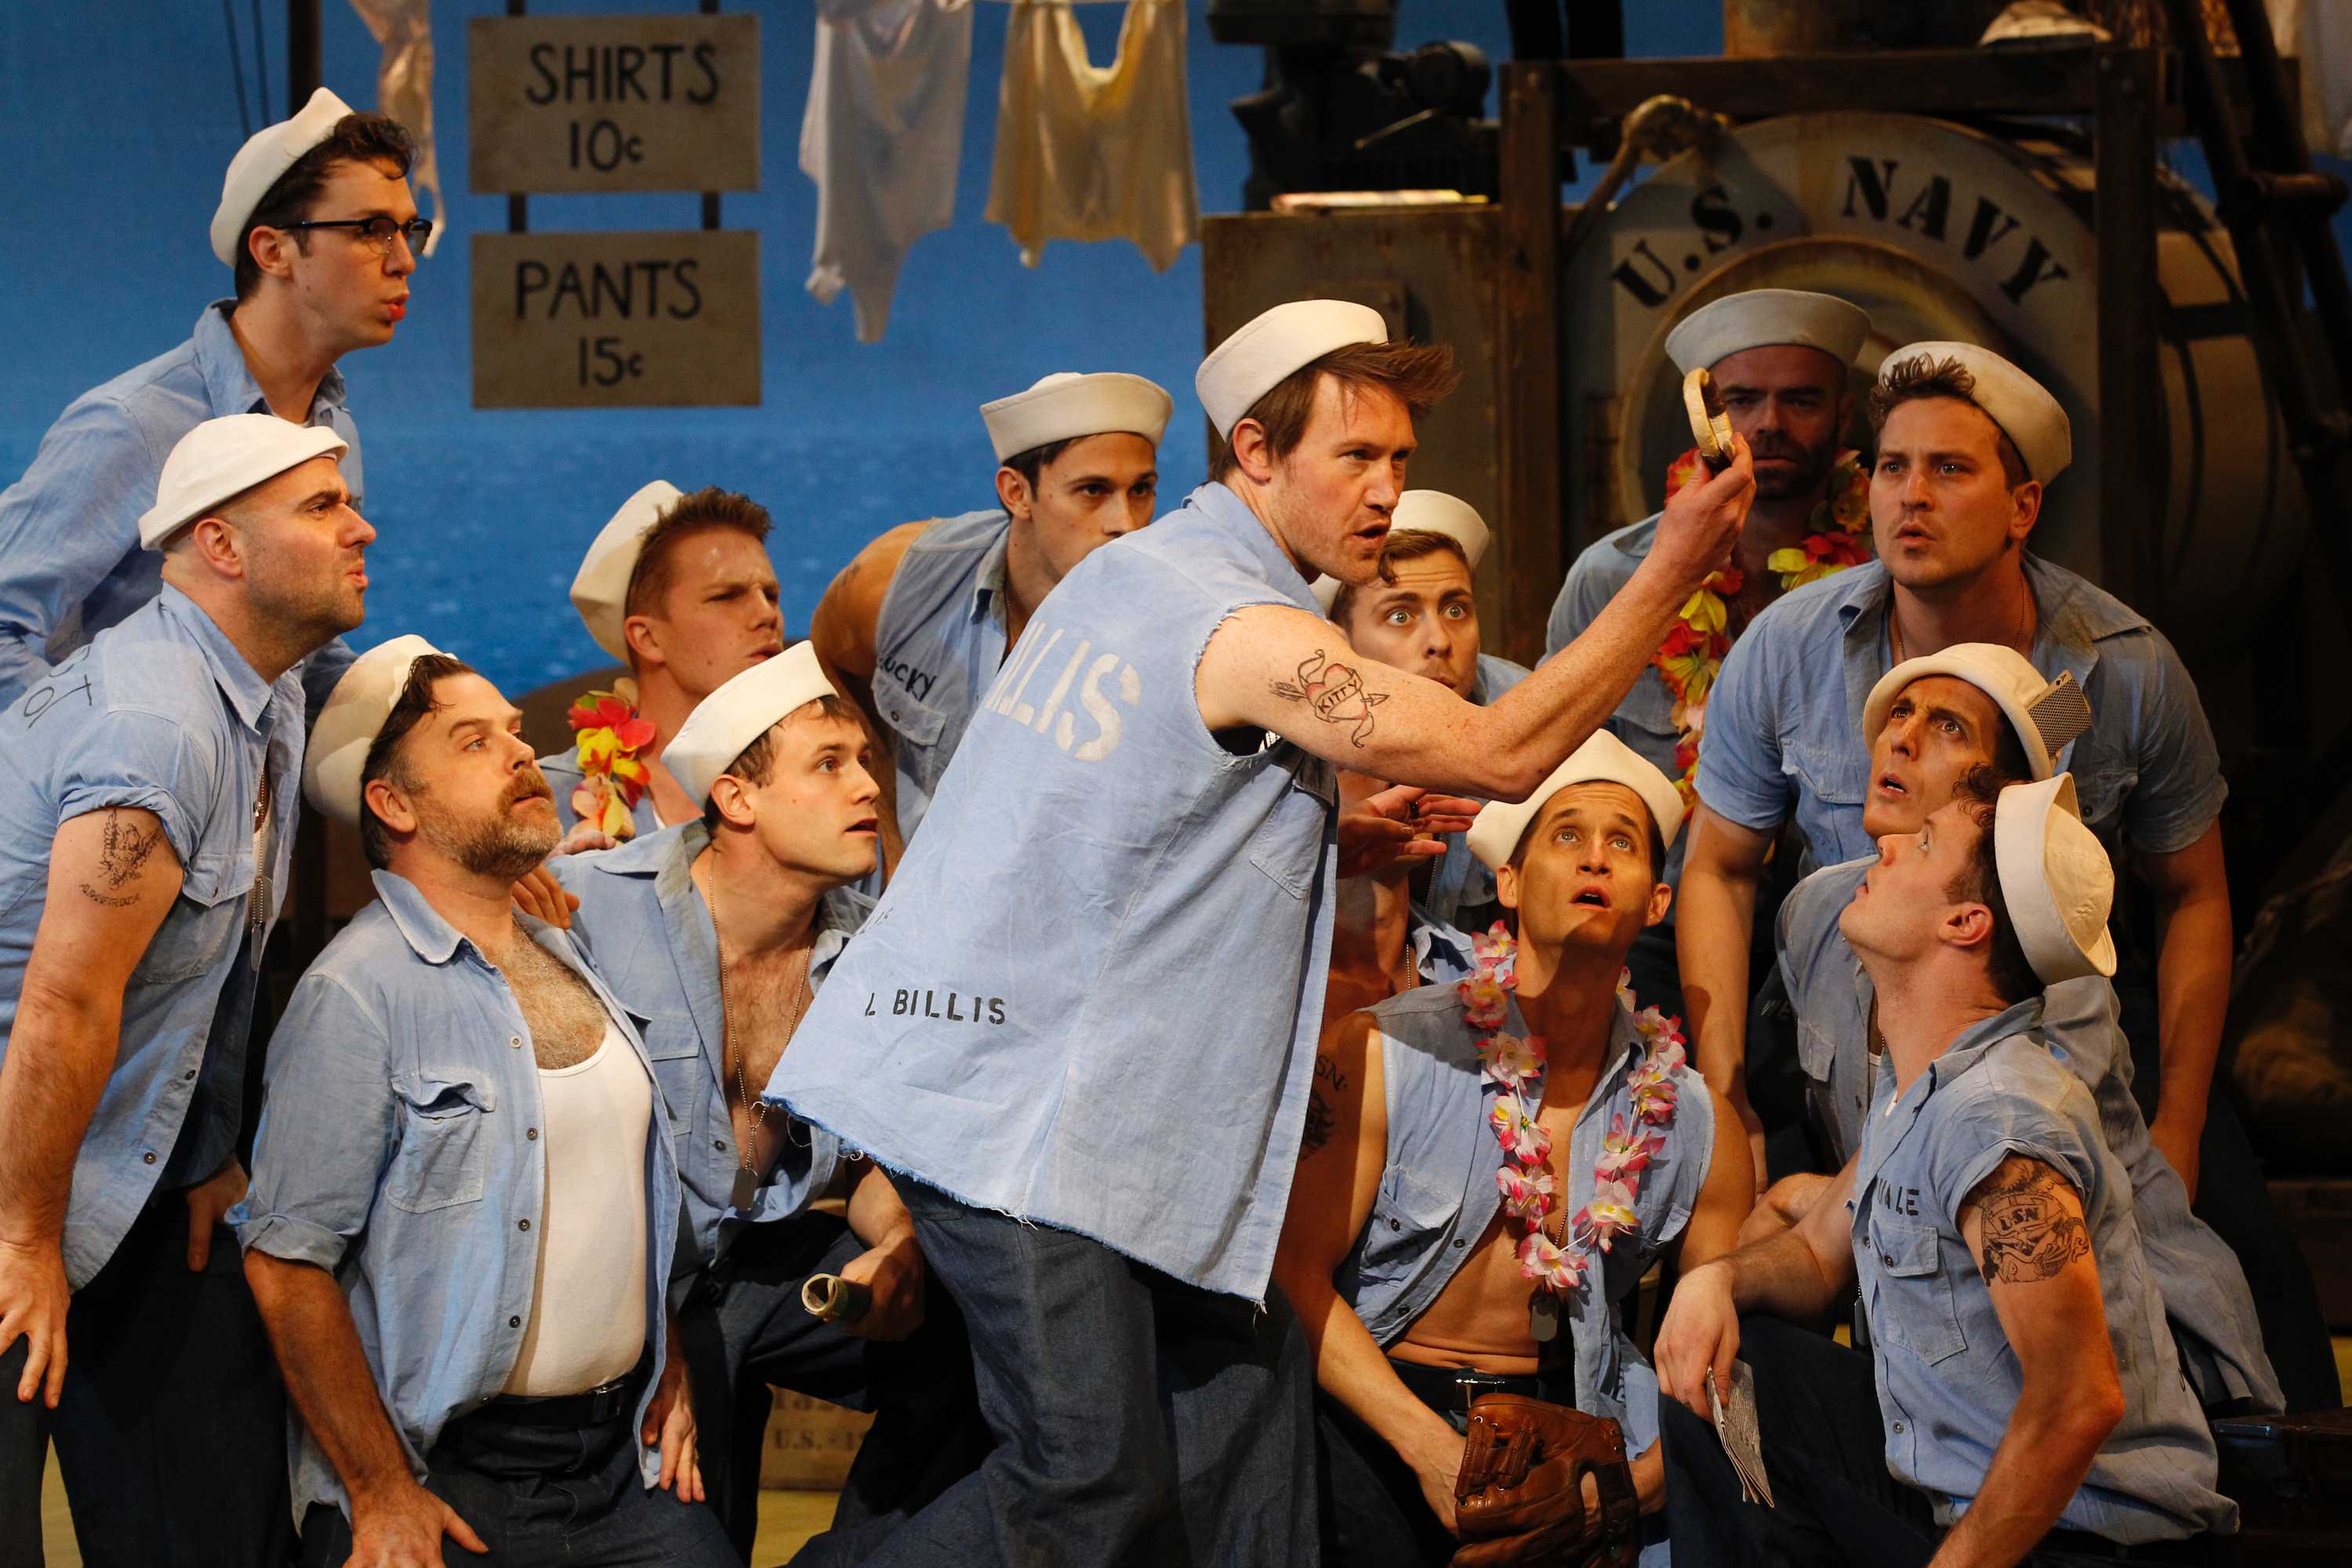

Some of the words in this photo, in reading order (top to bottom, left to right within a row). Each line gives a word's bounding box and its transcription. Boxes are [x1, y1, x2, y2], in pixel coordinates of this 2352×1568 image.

[526, 42, 720, 106] SHIRTS
[1610, 185, 1774, 307] U.S.
[1840, 155, 2070, 307] NAVY
[515, 260, 703, 321] PANTS
[879, 656, 938, 702] UCKY
[1317, 679, 1358, 714] KITTY
[892, 988, 1006, 1025] BILLIS
